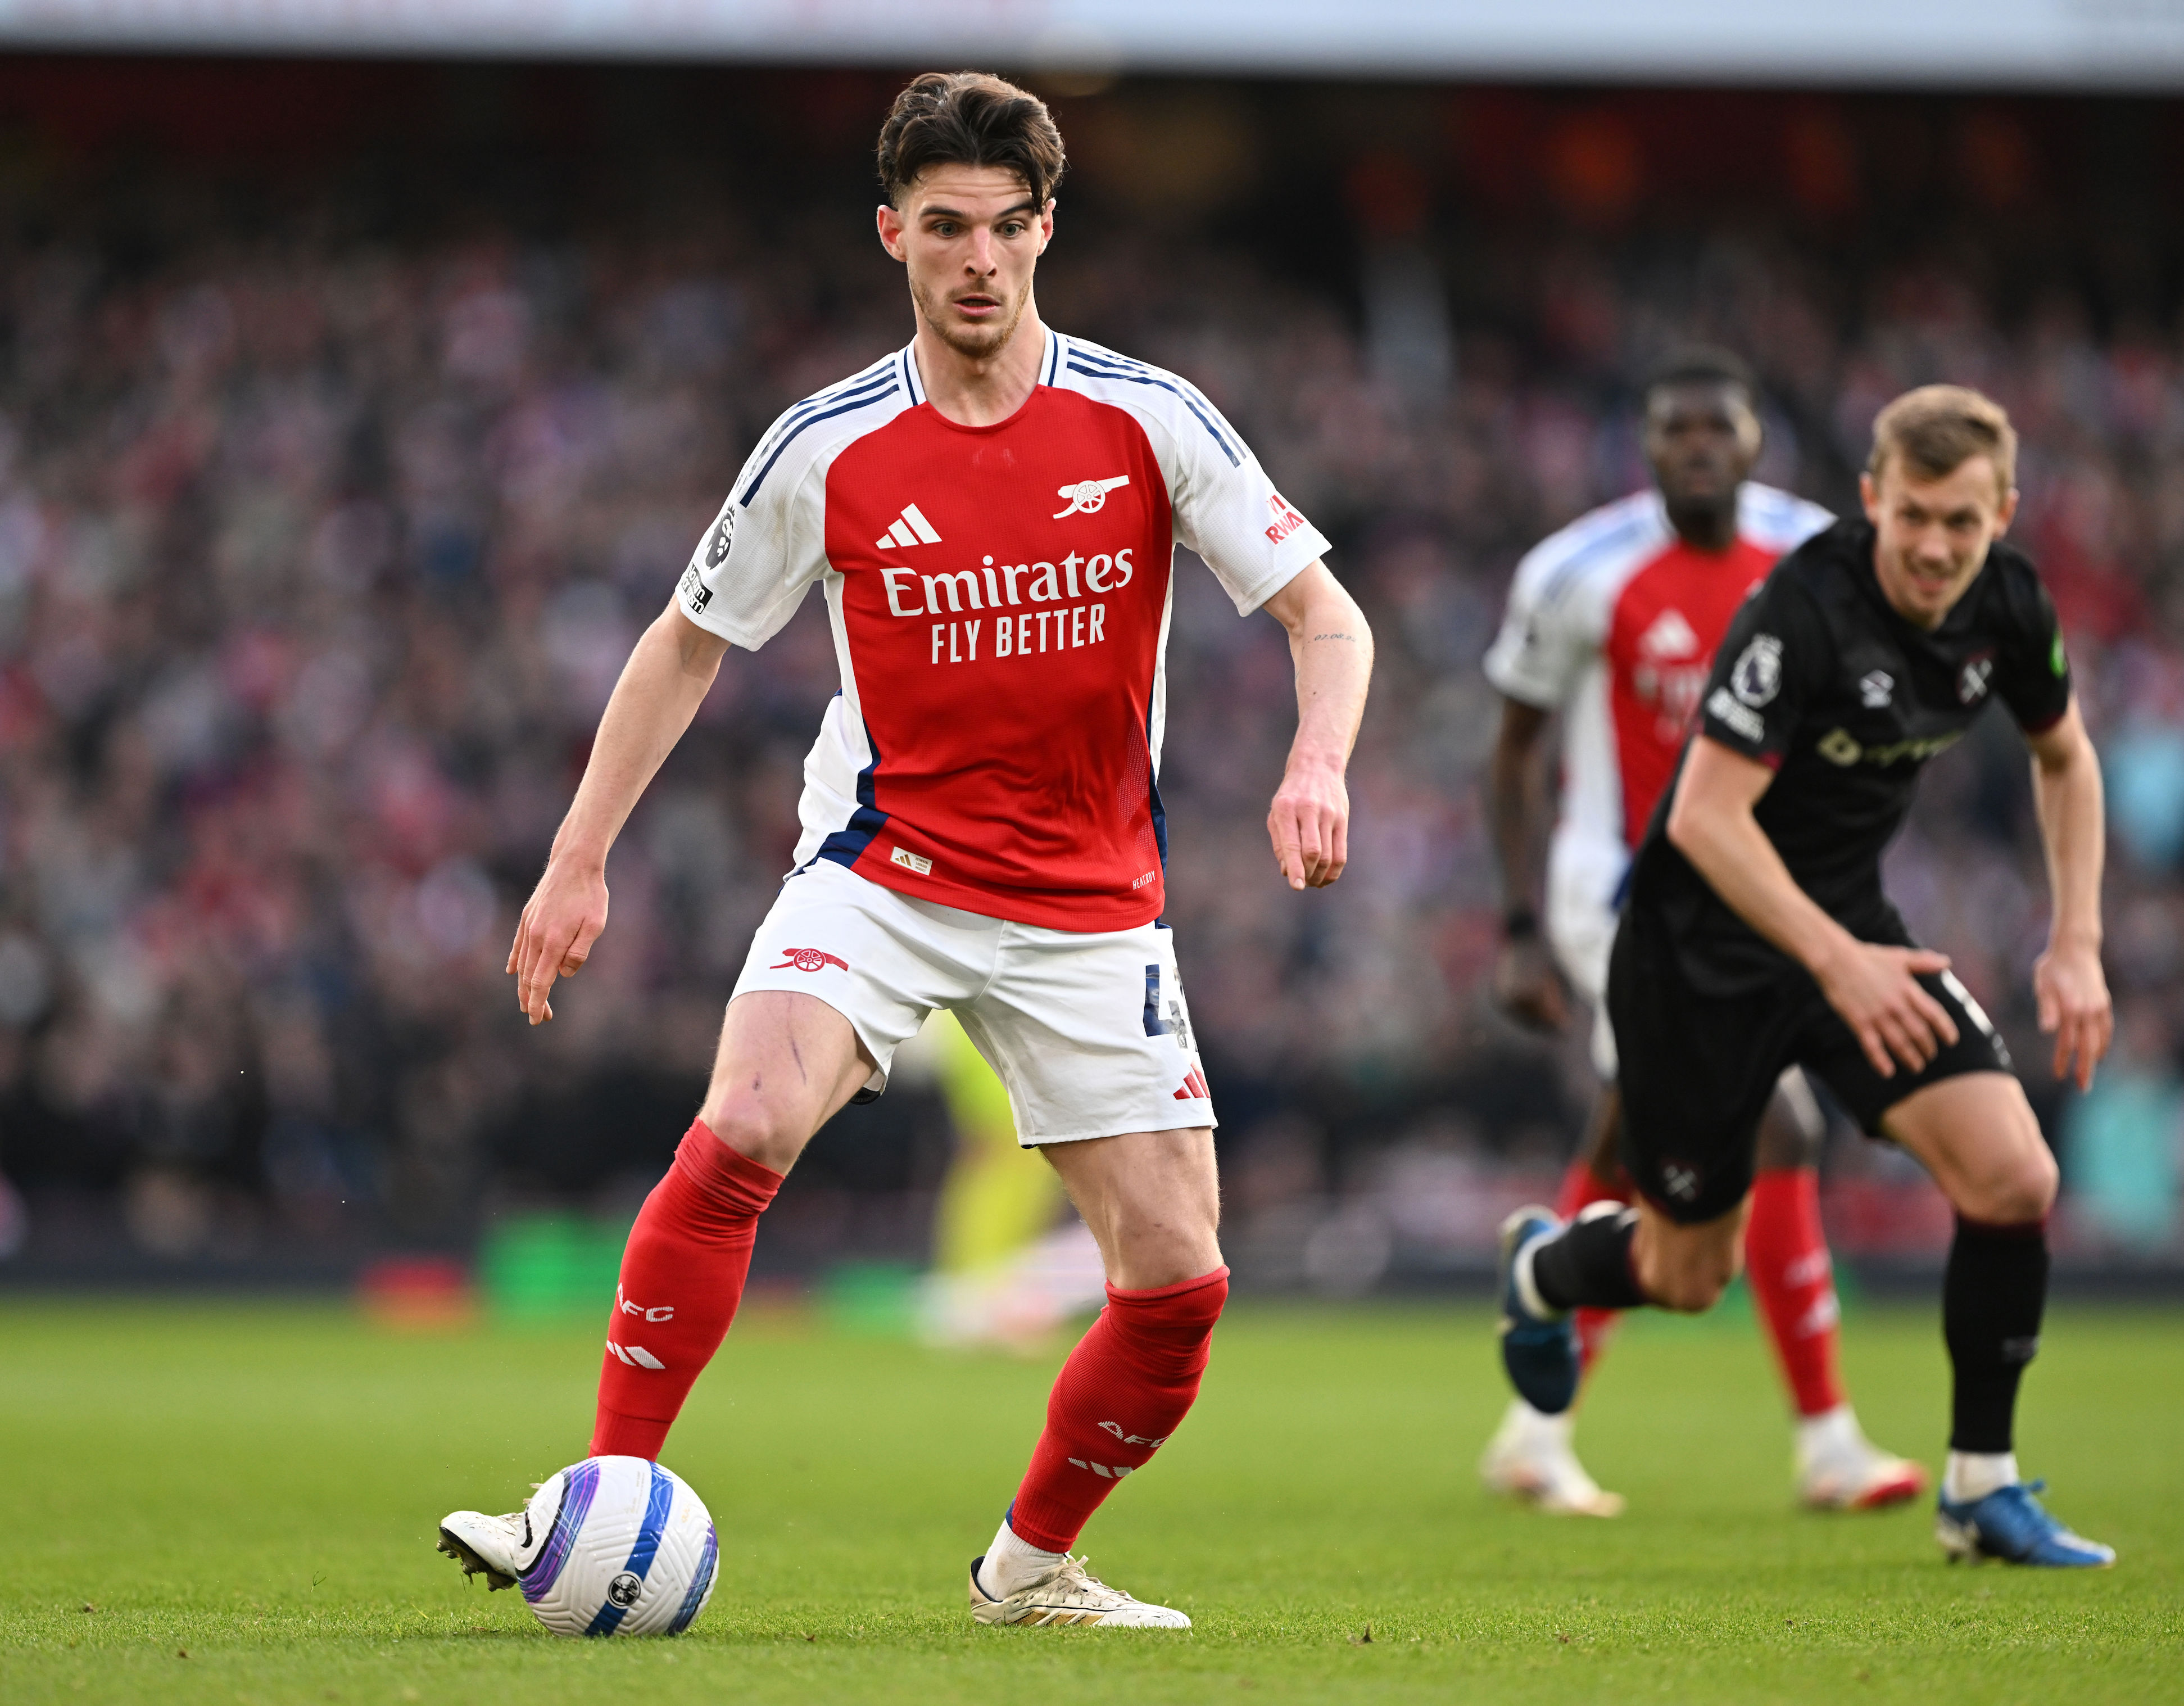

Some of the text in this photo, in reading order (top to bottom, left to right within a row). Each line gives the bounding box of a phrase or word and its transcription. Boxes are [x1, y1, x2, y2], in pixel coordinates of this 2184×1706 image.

[879, 548, 1133, 617] Emirates
[931, 603, 1105, 664] FLY BETTER
[1132, 870, 1156, 890] HEAT.RDY
[618, 1282, 674, 1322] AFC
[1097, 1420, 1172, 1449] AFC
